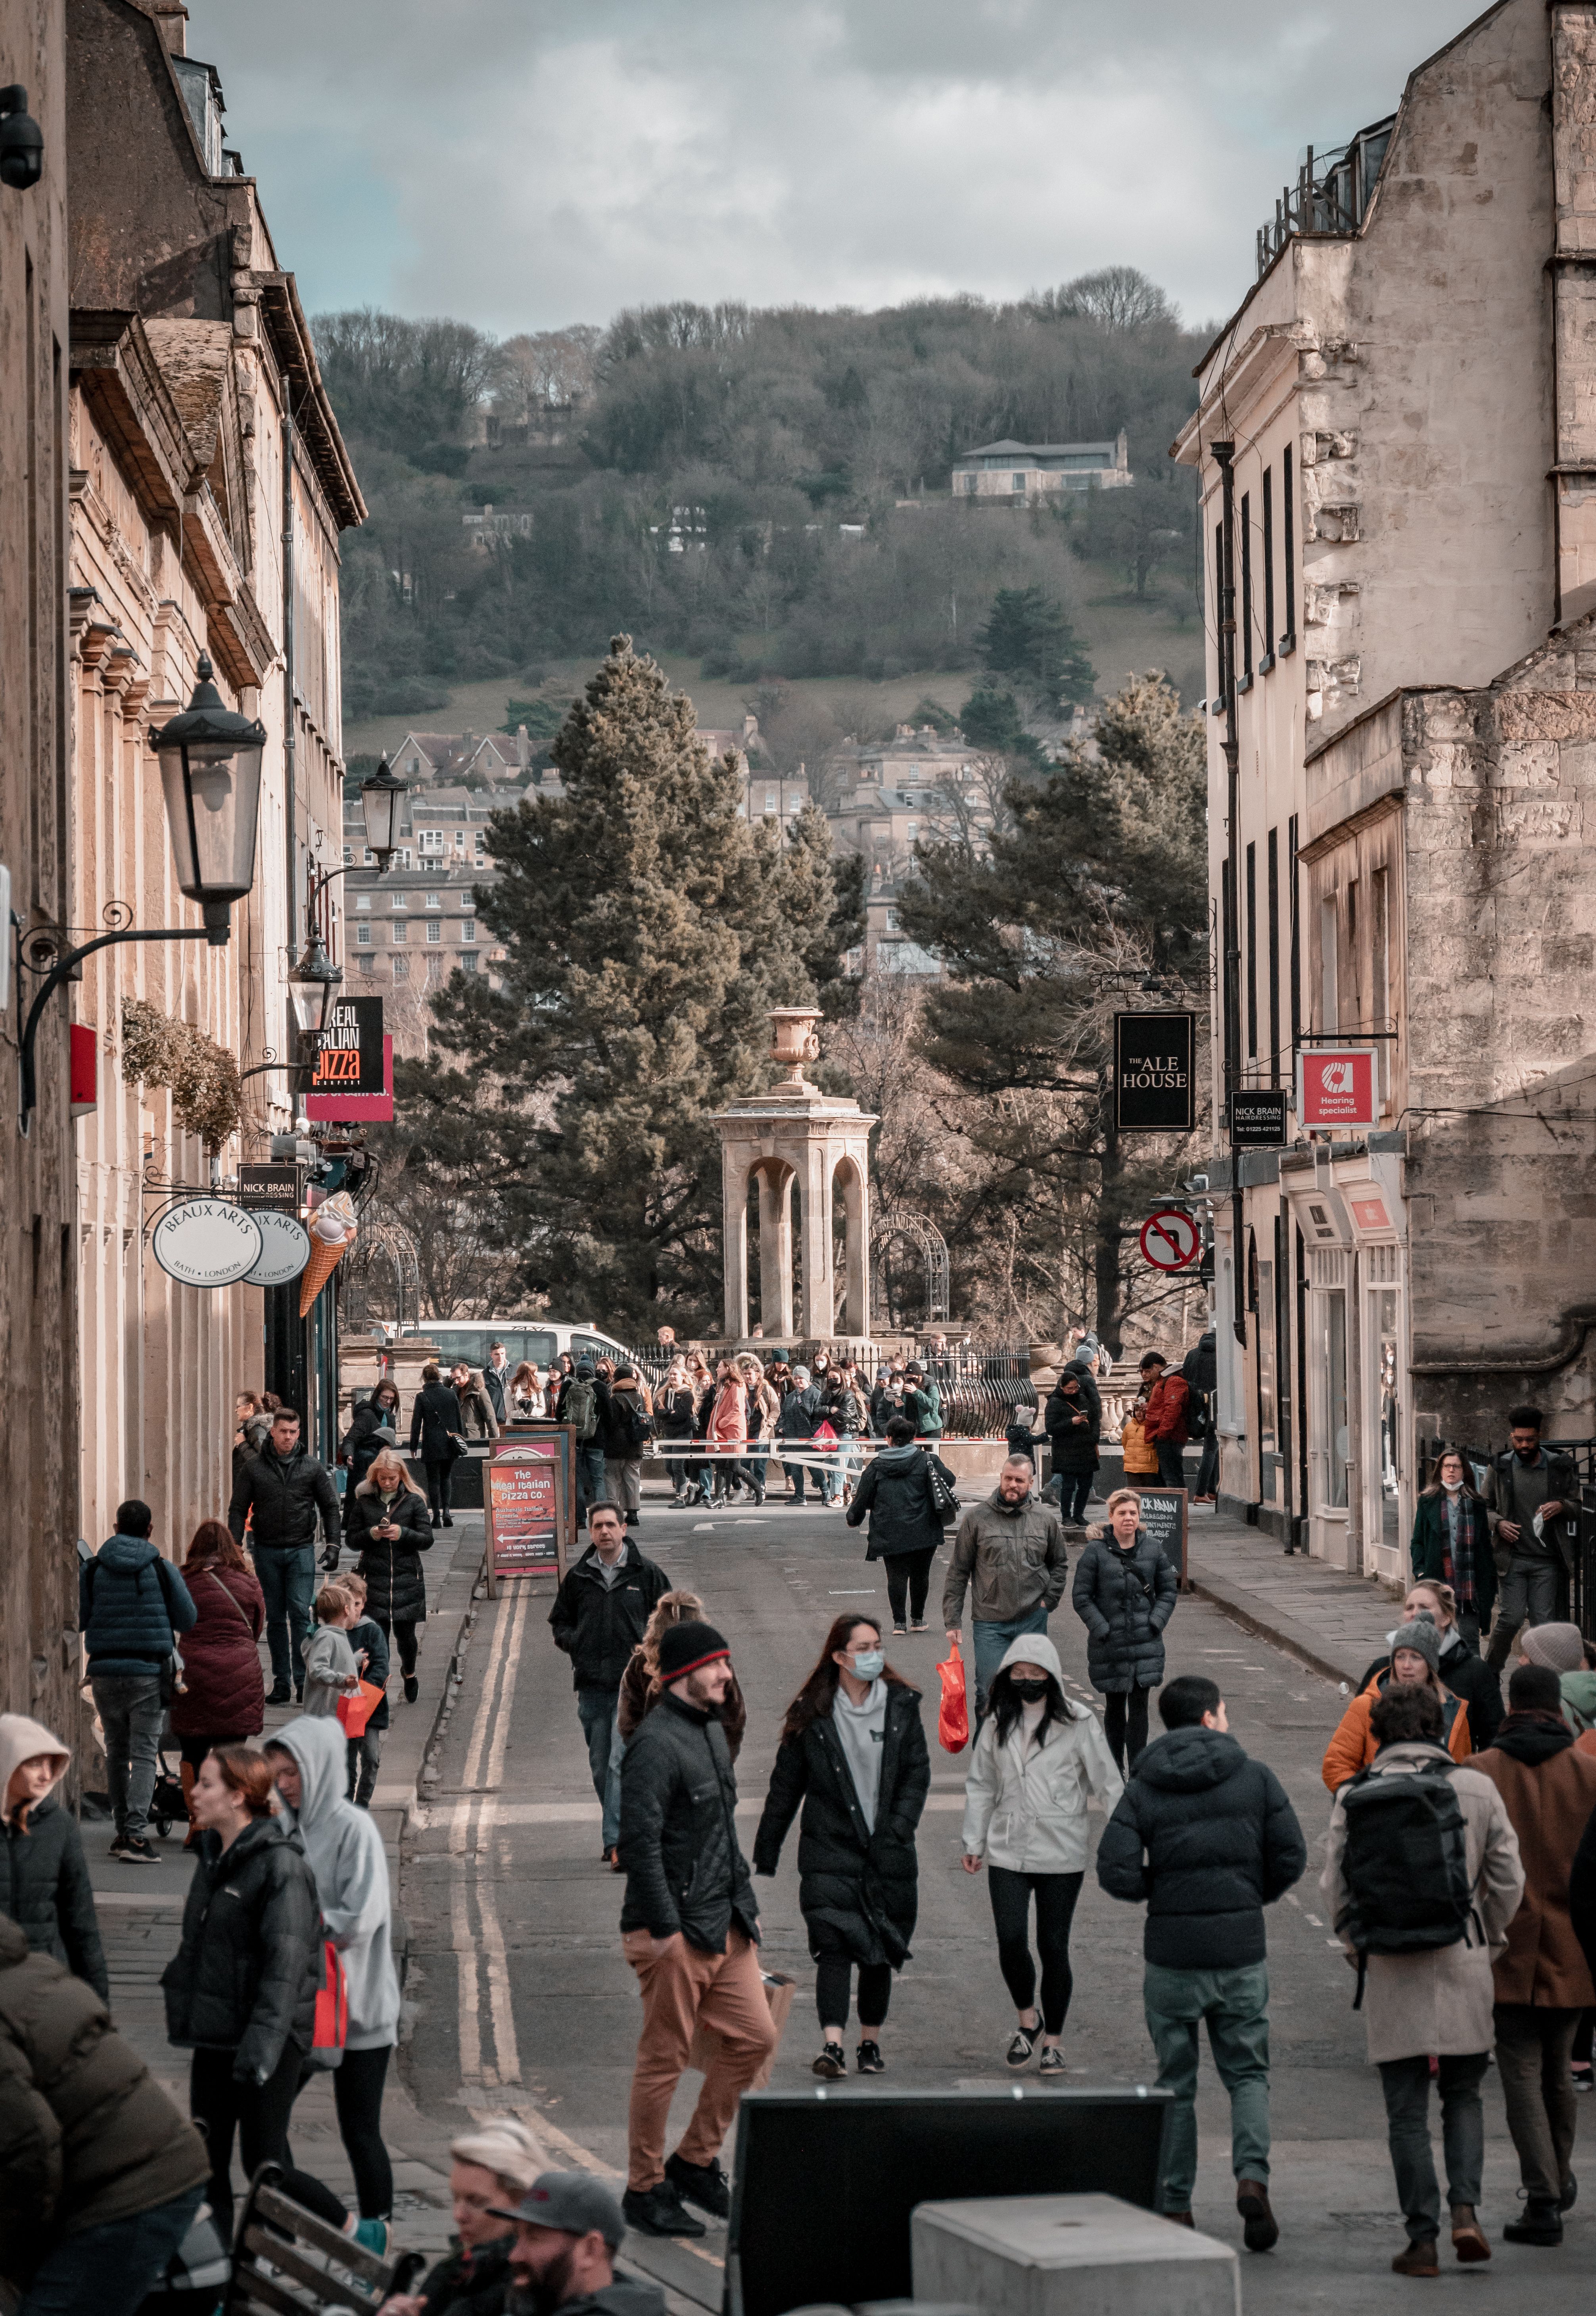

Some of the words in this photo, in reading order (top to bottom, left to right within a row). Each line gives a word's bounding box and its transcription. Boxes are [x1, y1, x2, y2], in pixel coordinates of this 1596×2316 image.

[1141, 1057, 1178, 1071] ALE
[1122, 1074, 1187, 1088] HOUSE
[1321, 1097, 1354, 1105] Hearing
[1319, 1107, 1357, 1116] specialist
[165, 1205, 213, 1232] BEAUX
[217, 1207, 252, 1234] ARTS
[274, 1218, 302, 1240] ARTS
[174, 1260, 195, 1275] BATH
[205, 1261, 241, 1277] LONDON
[265, 1264, 294, 1277] LONDON
[514, 1470, 531, 1479] The
[496, 1482, 515, 1490] Real
[518, 1480, 550, 1490] Italian
[1153, 1498, 1177, 1513] BRAIN
